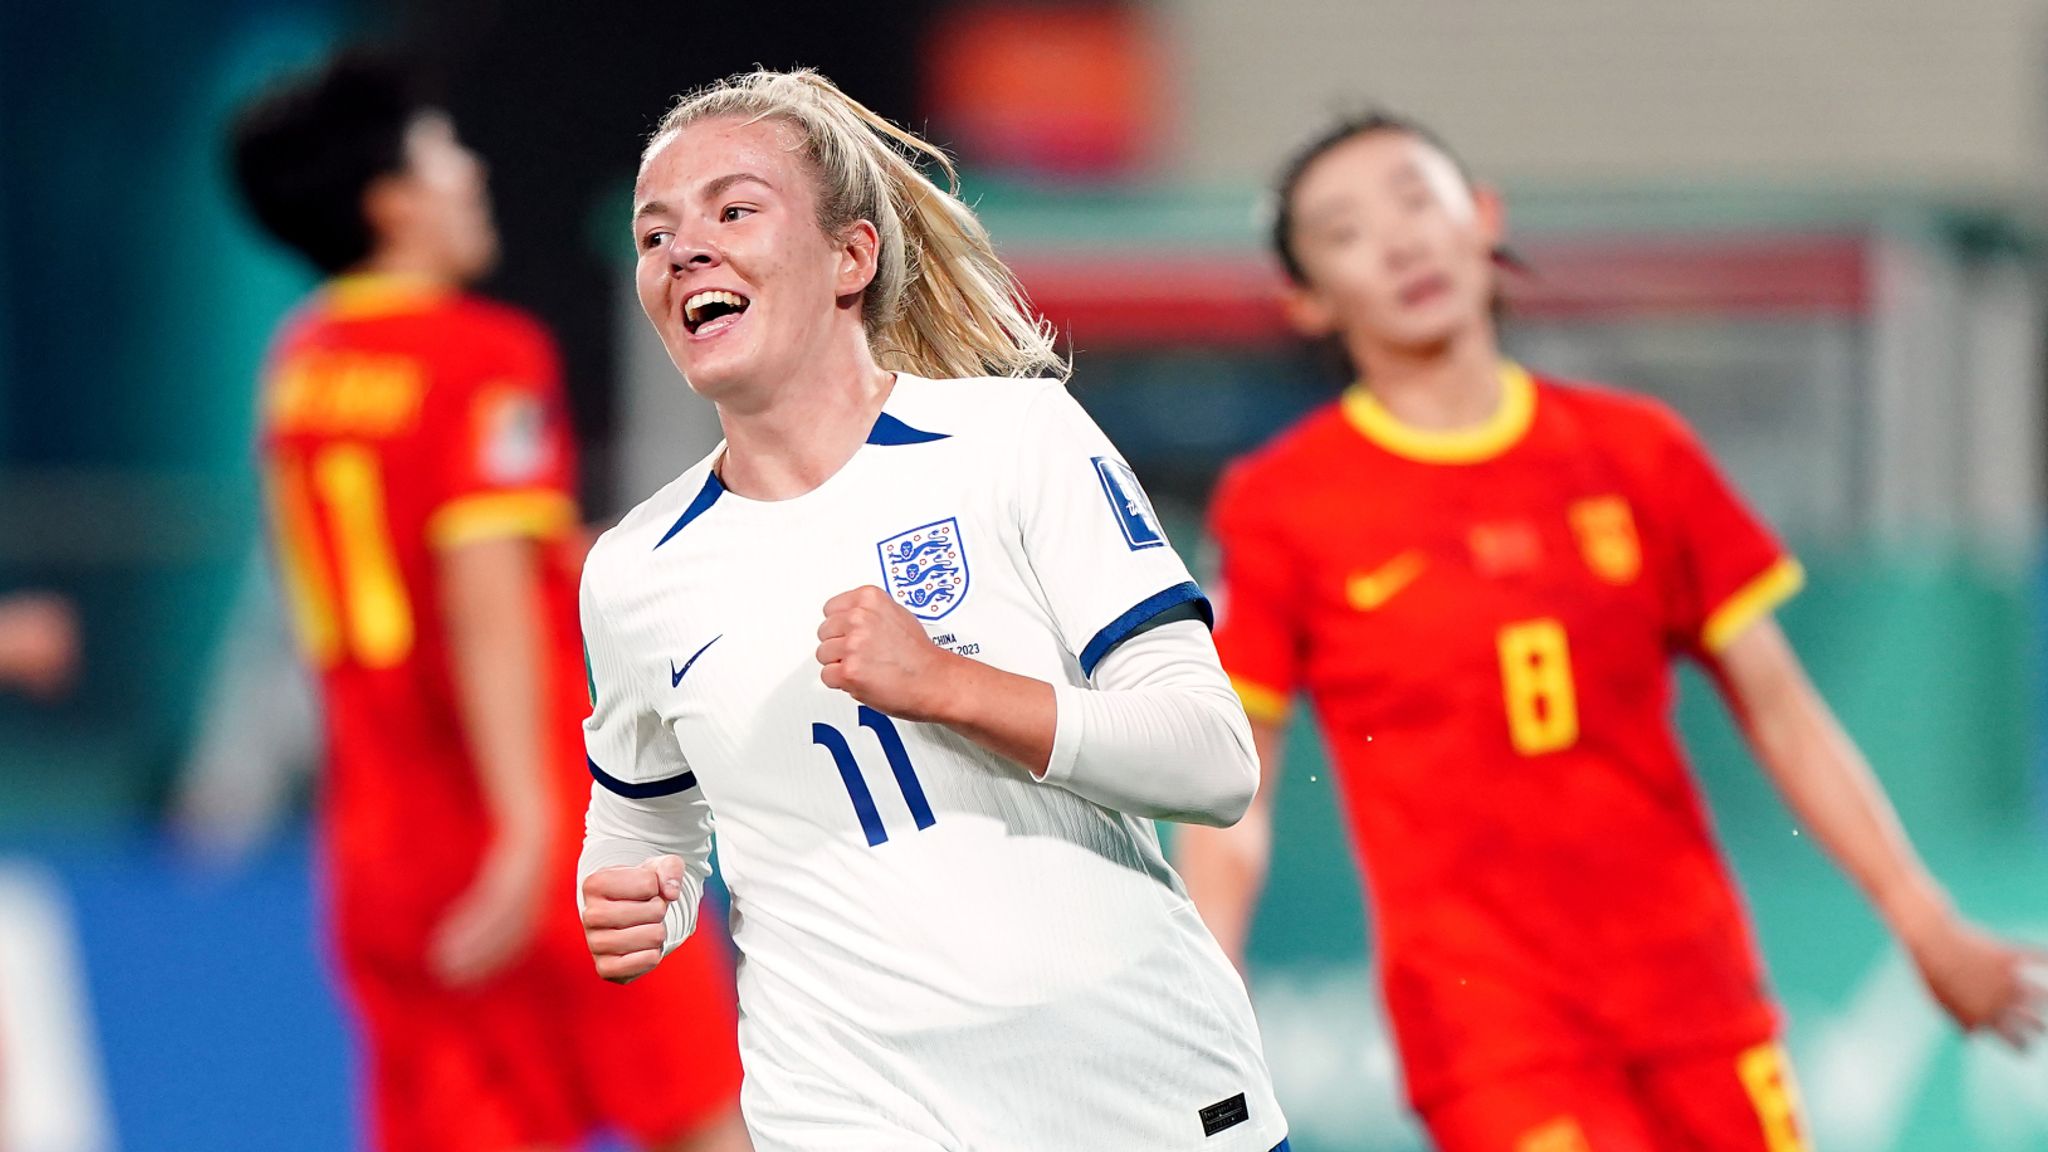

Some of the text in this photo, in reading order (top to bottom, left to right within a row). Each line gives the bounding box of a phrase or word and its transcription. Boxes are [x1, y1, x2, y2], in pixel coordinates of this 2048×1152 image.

[932, 633, 957, 646] CHINA
[957, 643, 980, 656] 2023
[1497, 617, 1579, 756] 8
[812, 705, 936, 847] 11
